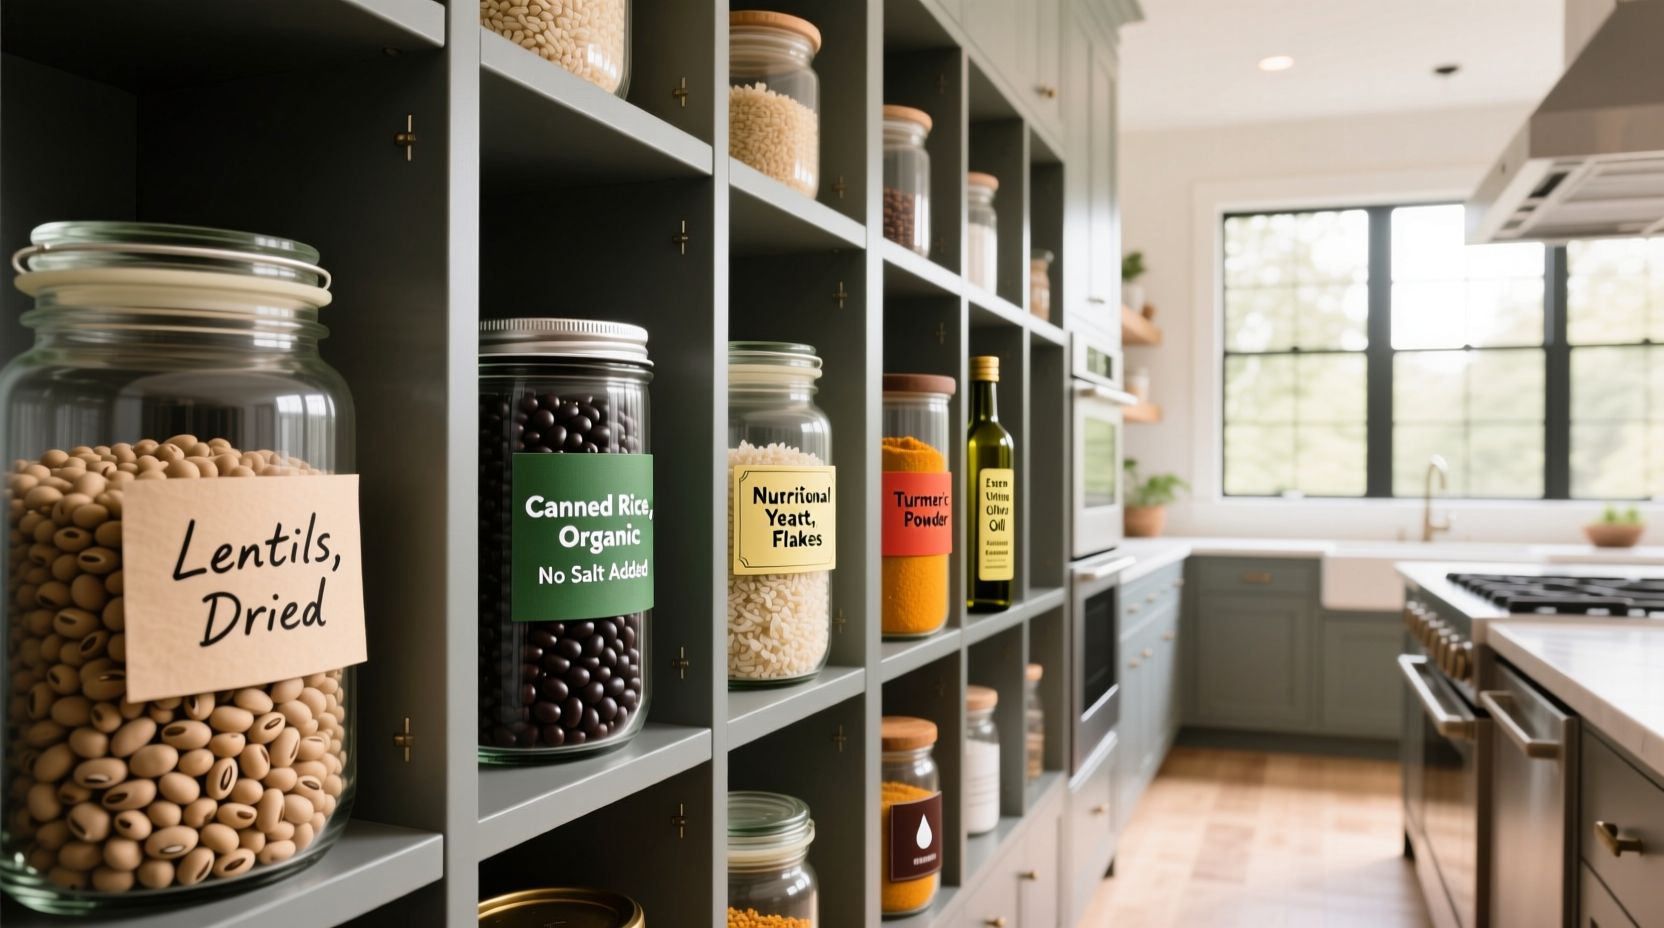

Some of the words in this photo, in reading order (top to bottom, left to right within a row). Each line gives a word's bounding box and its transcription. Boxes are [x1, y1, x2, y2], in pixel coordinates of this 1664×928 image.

[525, 494, 613, 518] Canned
[618, 493, 654, 520] Rice,
[172, 511, 341, 581] Lentils,
[558, 523, 641, 554] Organic
[772, 530, 823, 548] Flakes
[538, 566, 566, 585] No
[571, 563, 605, 584] Salt
[608, 558, 648, 581] Added
[199, 576, 327, 647] Dried
